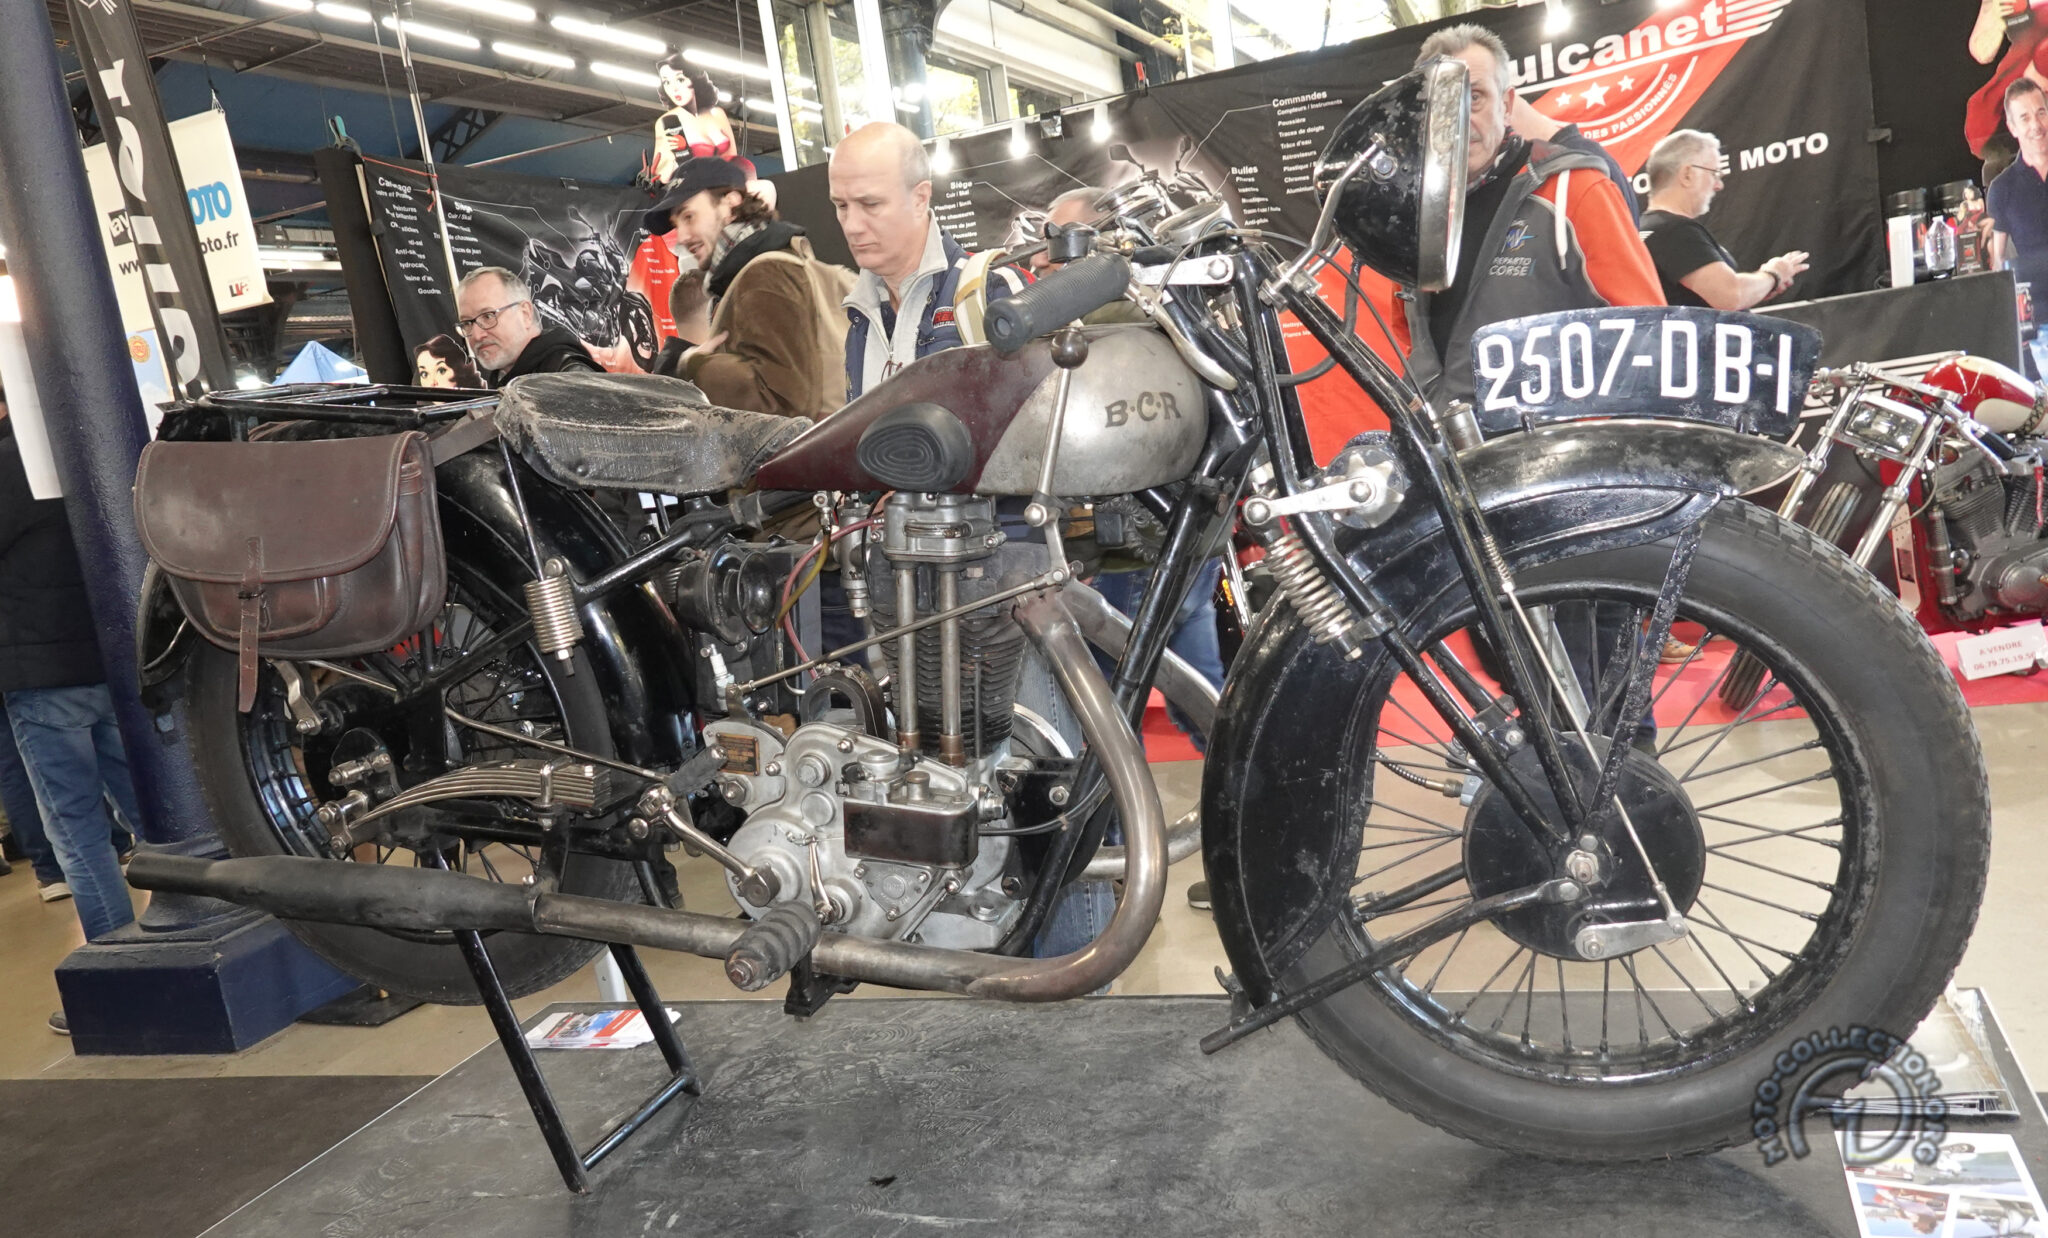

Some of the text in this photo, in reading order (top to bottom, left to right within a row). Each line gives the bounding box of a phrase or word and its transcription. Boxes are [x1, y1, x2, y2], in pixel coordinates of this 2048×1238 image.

[1508, 1, 1724, 87] ulcanet
[1272, 91, 1328, 107] Commandes
[1583, 128, 1609, 140] DES
[1740, 132, 1829, 171] MOTO
[1231, 166, 1259, 175] Bulles
[188, 181, 233, 225] OTO
[1488, 265, 1530, 277] CORSE
[1987, 640, 2023, 654] VENDRE
